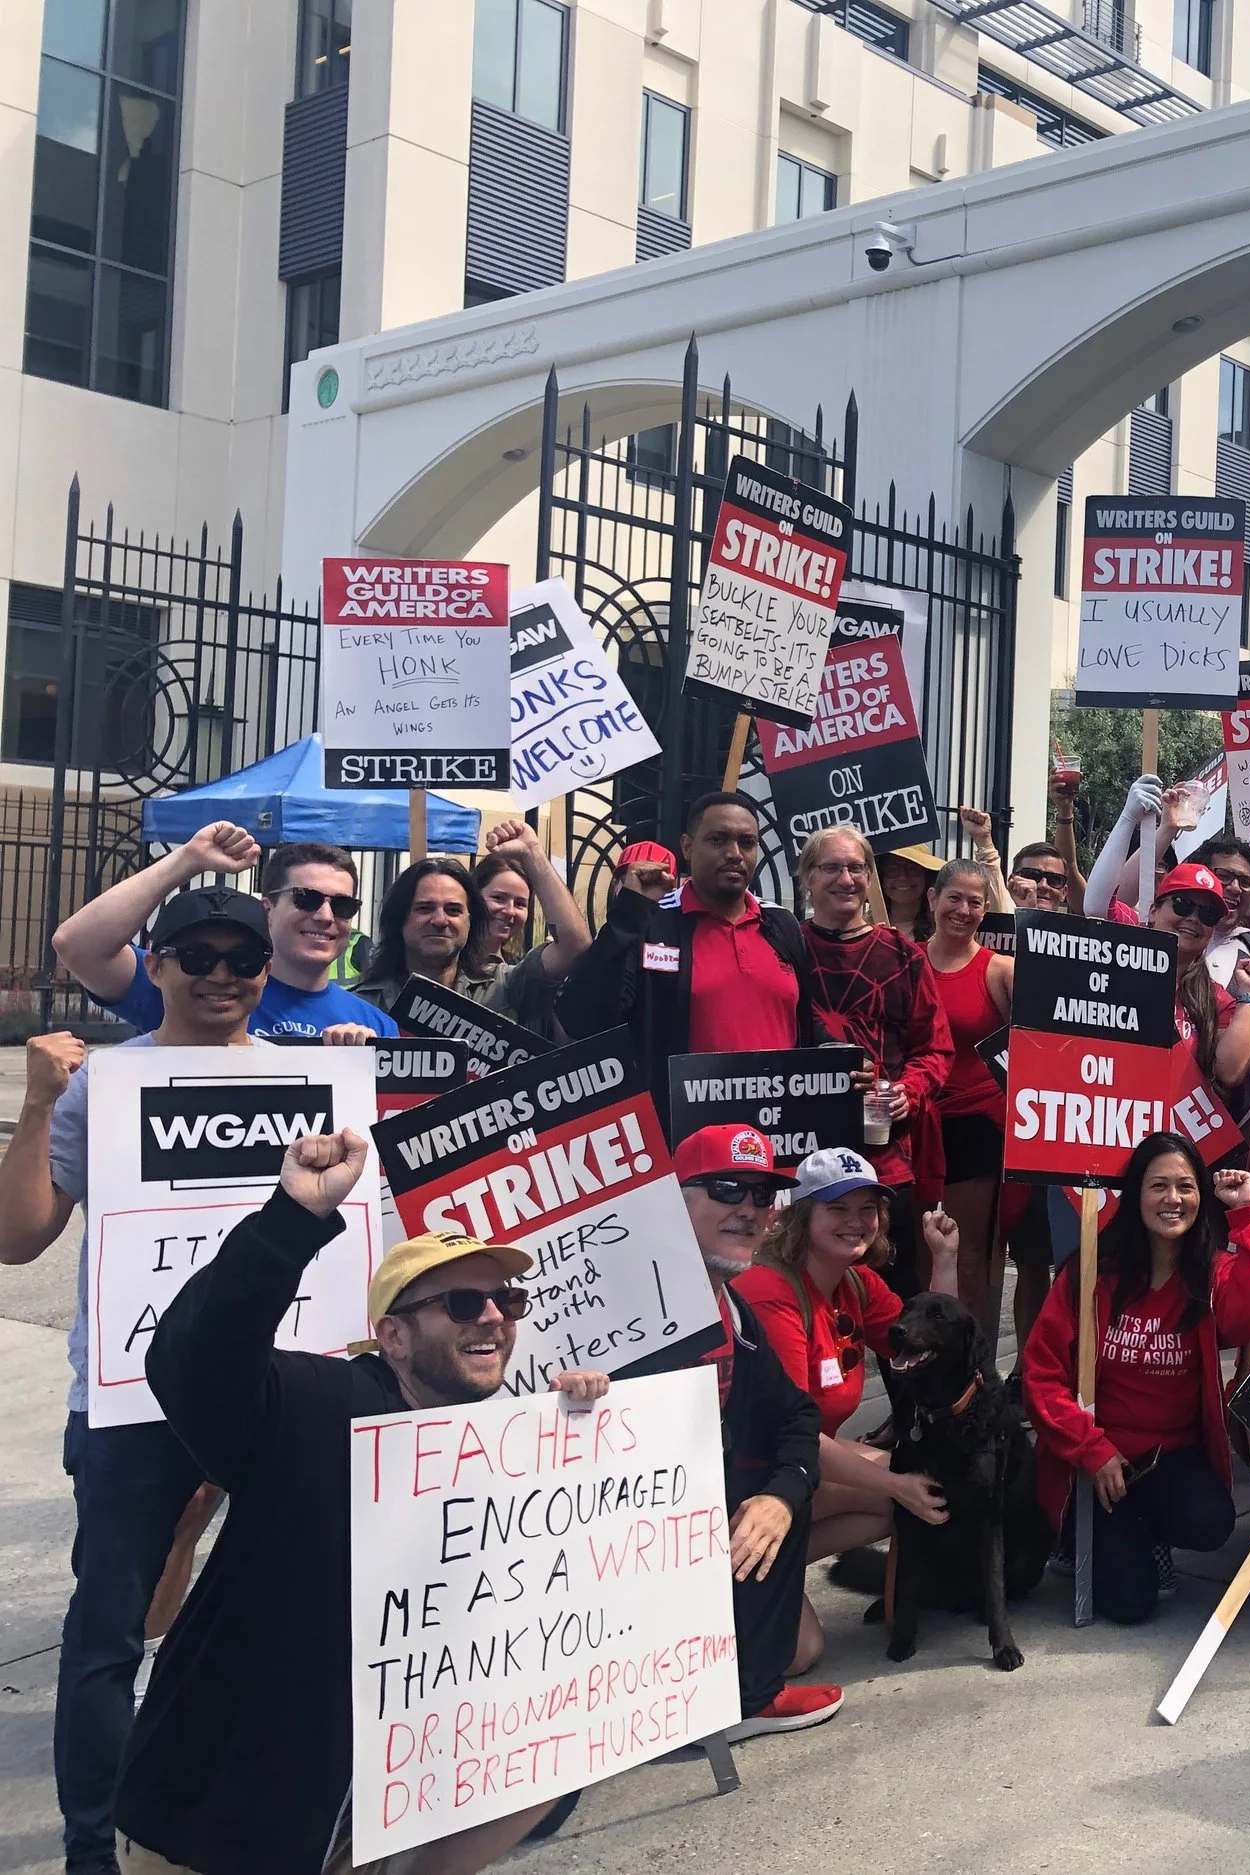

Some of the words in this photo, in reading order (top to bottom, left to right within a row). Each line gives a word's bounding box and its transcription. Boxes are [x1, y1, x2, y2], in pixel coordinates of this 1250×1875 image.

[736, 474, 801, 520] WRITERS
[803, 505, 843, 538] GUILD
[1096, 510, 1177, 529] WRITERS
[1181, 511, 1234, 531] GUILD
[779, 520, 794, 536] ON
[1155, 532, 1172, 544] ON
[721, 519, 837, 598] STRIKE!
[1093, 548, 1232, 588] STRIKE!
[342, 566, 489, 585] WRITERS
[347, 584, 449, 601] GUILD
[451, 589, 482, 601] OF
[708, 574, 777, 622] BUCKLE
[788, 601, 828, 639] YOUR
[338, 602, 493, 618] AMERICA
[1082, 599, 1108, 622] I
[1125, 600, 1229, 635] USUALLY
[378, 655, 460, 684] HONK
[697, 628, 749, 660] GOING
[754, 651, 767, 669] TO
[773, 659, 794, 680] BE
[796, 673, 810, 688] A
[1081, 644, 1144, 669] LOVE
[693, 655, 755, 693] BUMPY
[759, 678, 816, 712] STRIKE
[862, 684, 890, 705] OF
[511, 700, 643, 790] WELCOME
[341, 755, 496, 782] STRIKE
[829, 765, 863, 798] ON
[1027, 928, 1112, 965] WRITERS
[1116, 943, 1169, 974] GUILD
[1089, 972, 1110, 993] OF
[273, 1021, 316, 1036] GUILD
[1053, 997, 1139, 1031] AMERICA
[1080, 1054, 1114, 1086] ON
[684, 1076, 785, 1102] WRITERS
[789, 1072, 850, 1097] GUILD
[397, 1091, 535, 1171] WRITERS
[536, 1057, 624, 1112] GUILD
[759, 1107, 781, 1126] OF
[507, 1127, 537, 1155] ON
[837, 1154, 862, 1172] LA
[533, 1291, 605, 1332] with
[1144, 1318, 1160, 1332] AN
[1103, 1342, 1116, 1360] TO
[1121, 1348, 1138, 1364] BE
[1150, 1333, 1181, 1350] JUST
[354, 1407, 638, 1503] TEACHERS
[440, 1464, 687, 1564] ENCOURAGED
[379, 1582, 448, 1646] ME
[467, 1559, 524, 1613] AS
[545, 1548, 569, 1595] A
[368, 1624, 524, 1719] THANK
[387, 1713, 443, 1775] DR.
[454, 1677, 579, 1759] RHONDA
[383, 1772, 442, 1829] DR.
[454, 1732, 577, 1808] BRETT
[588, 1686, 698, 1772] HURSEY
